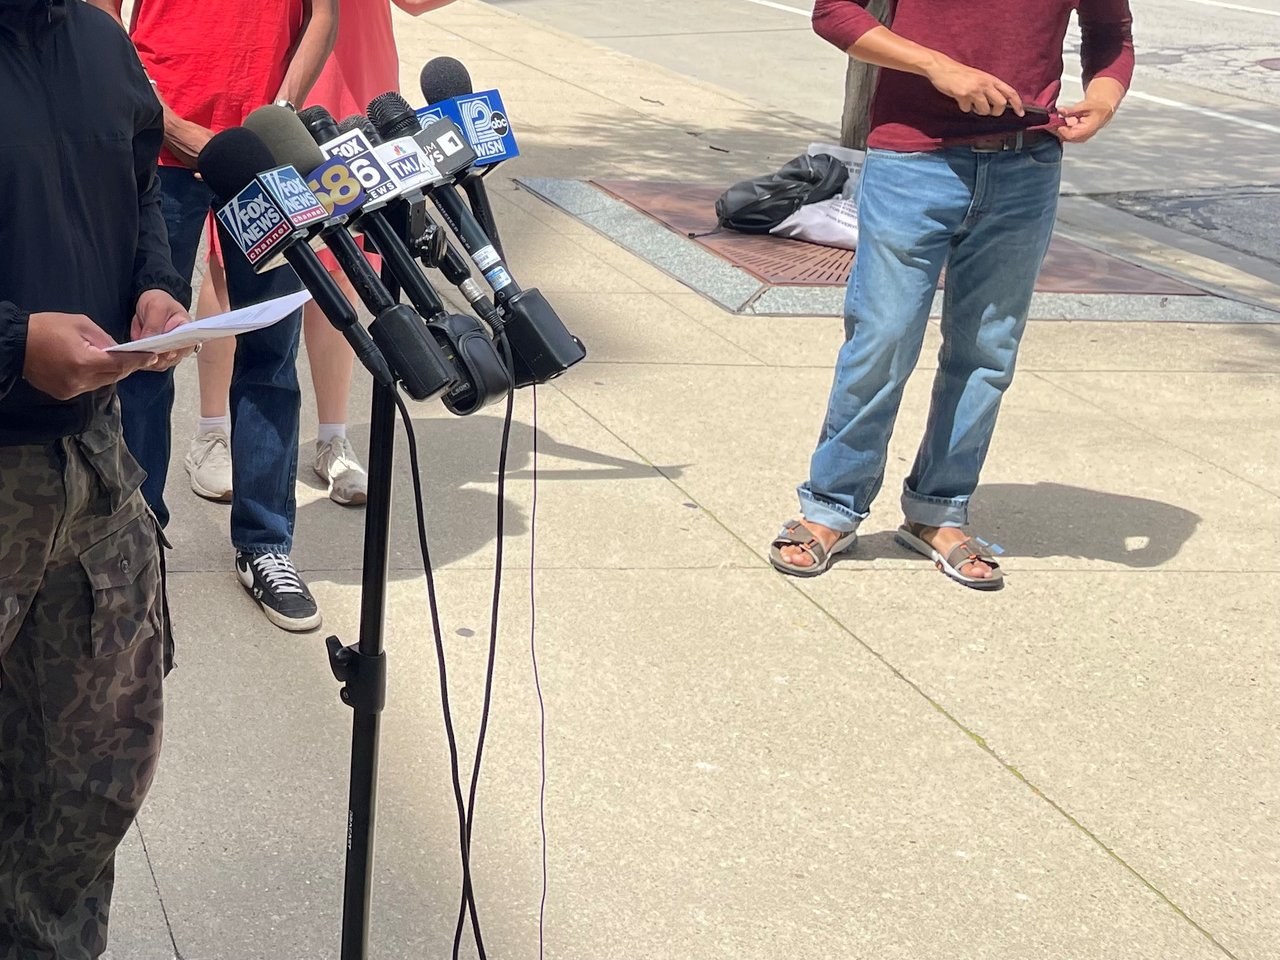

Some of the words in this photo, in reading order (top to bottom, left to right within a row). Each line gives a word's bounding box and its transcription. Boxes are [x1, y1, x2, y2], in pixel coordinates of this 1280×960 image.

[491, 117, 507, 130] abc
[447, 136, 459, 148] 1
[474, 139, 504, 158] WISN
[349, 158, 381, 189] 6
[280, 177, 308, 197] FOX
[368, 182, 395, 201] EWS
[239, 193, 272, 227] FOX
[285, 192, 317, 213] NEWS
[293, 208, 324, 223] channel
[242, 207, 280, 247] NEWS
[250, 223, 289, 259] channel
